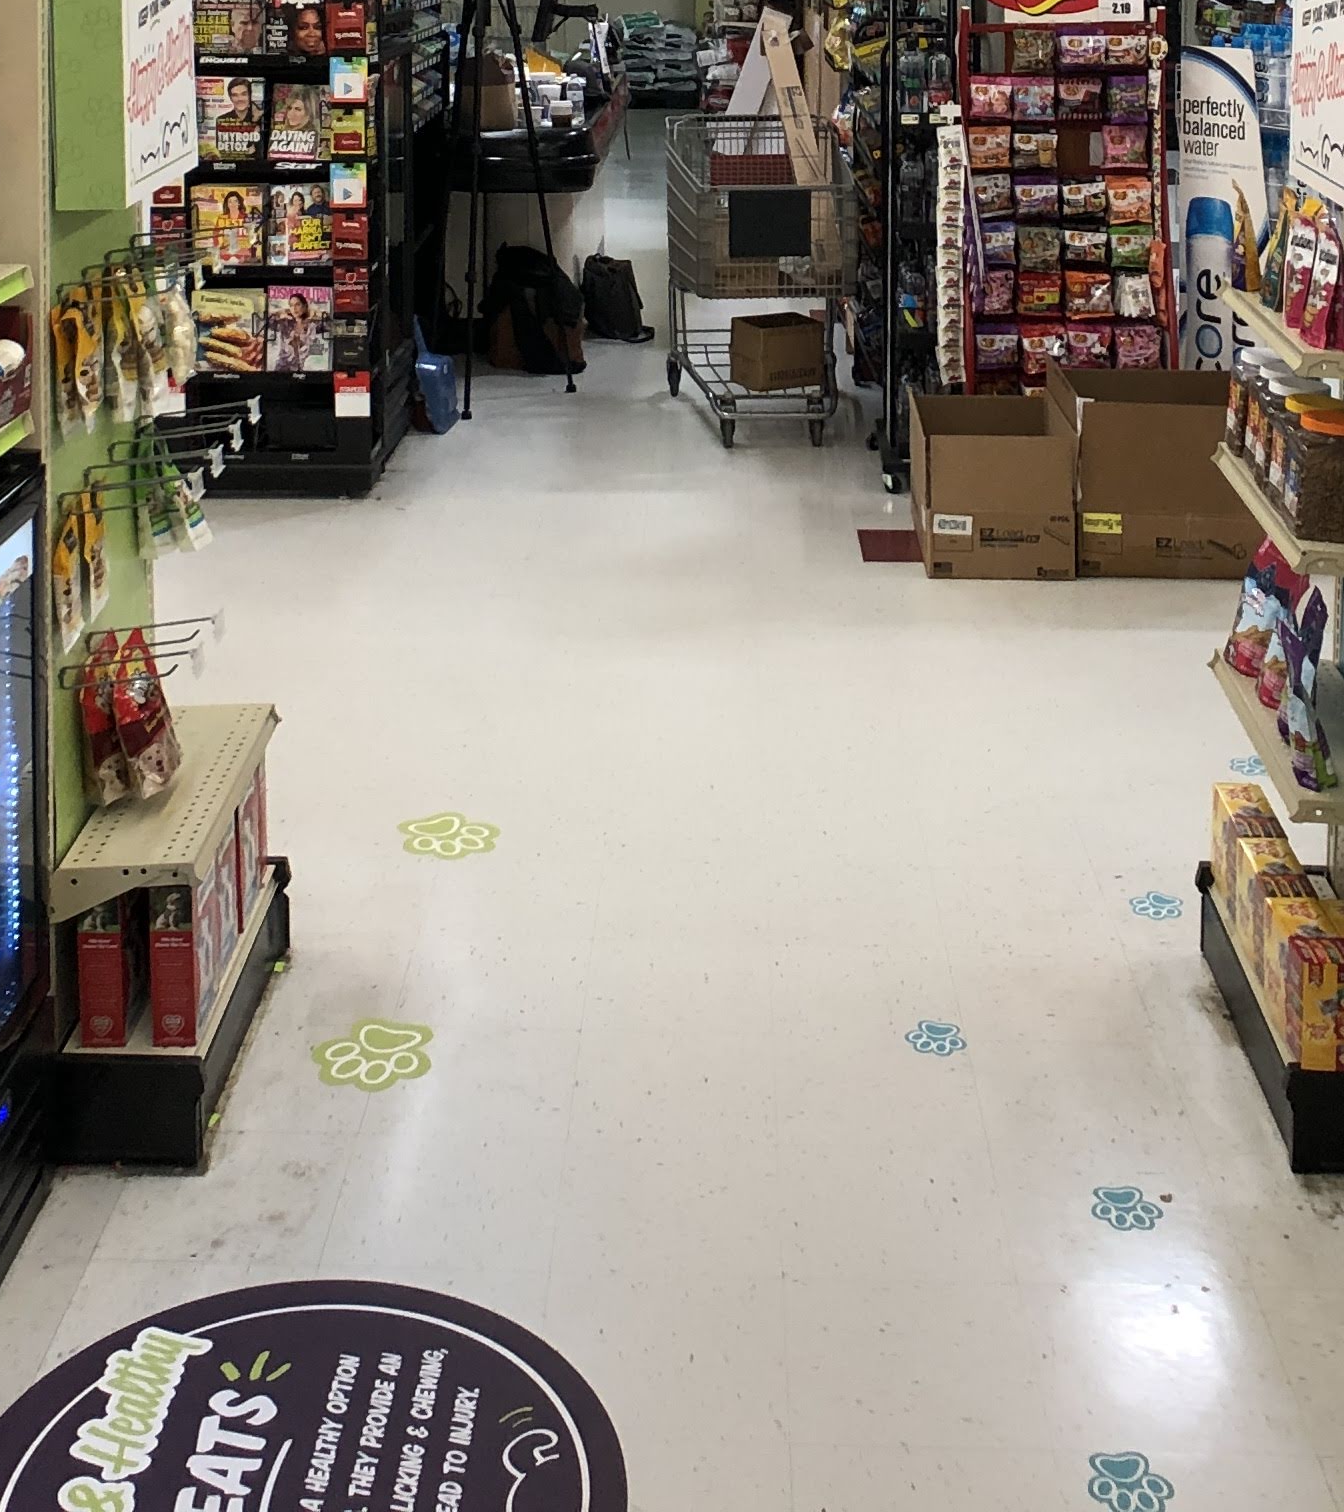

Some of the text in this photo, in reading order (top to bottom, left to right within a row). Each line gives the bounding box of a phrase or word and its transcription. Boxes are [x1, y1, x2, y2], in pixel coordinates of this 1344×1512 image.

[1112, 2, 1131, 15] 2.19
[1183, 98, 1245, 123] perfectly
[271, 130, 316, 142] DATING
[1183, 119, 1246, 140] balanced
[1183, 139, 1219, 157] water
[80, 1331, 203, 1475] Healthy
[305, 1353, 360, 1495] HEALTHY OPTION
[349, 1352, 402, 1498] THEY PROVIDE AN
[449, 1386, 481, 1446] INJURY.
[390, 1347, 449, 1512] LICKING & CHEWING,
[443, 1449, 468, 1474] TO
